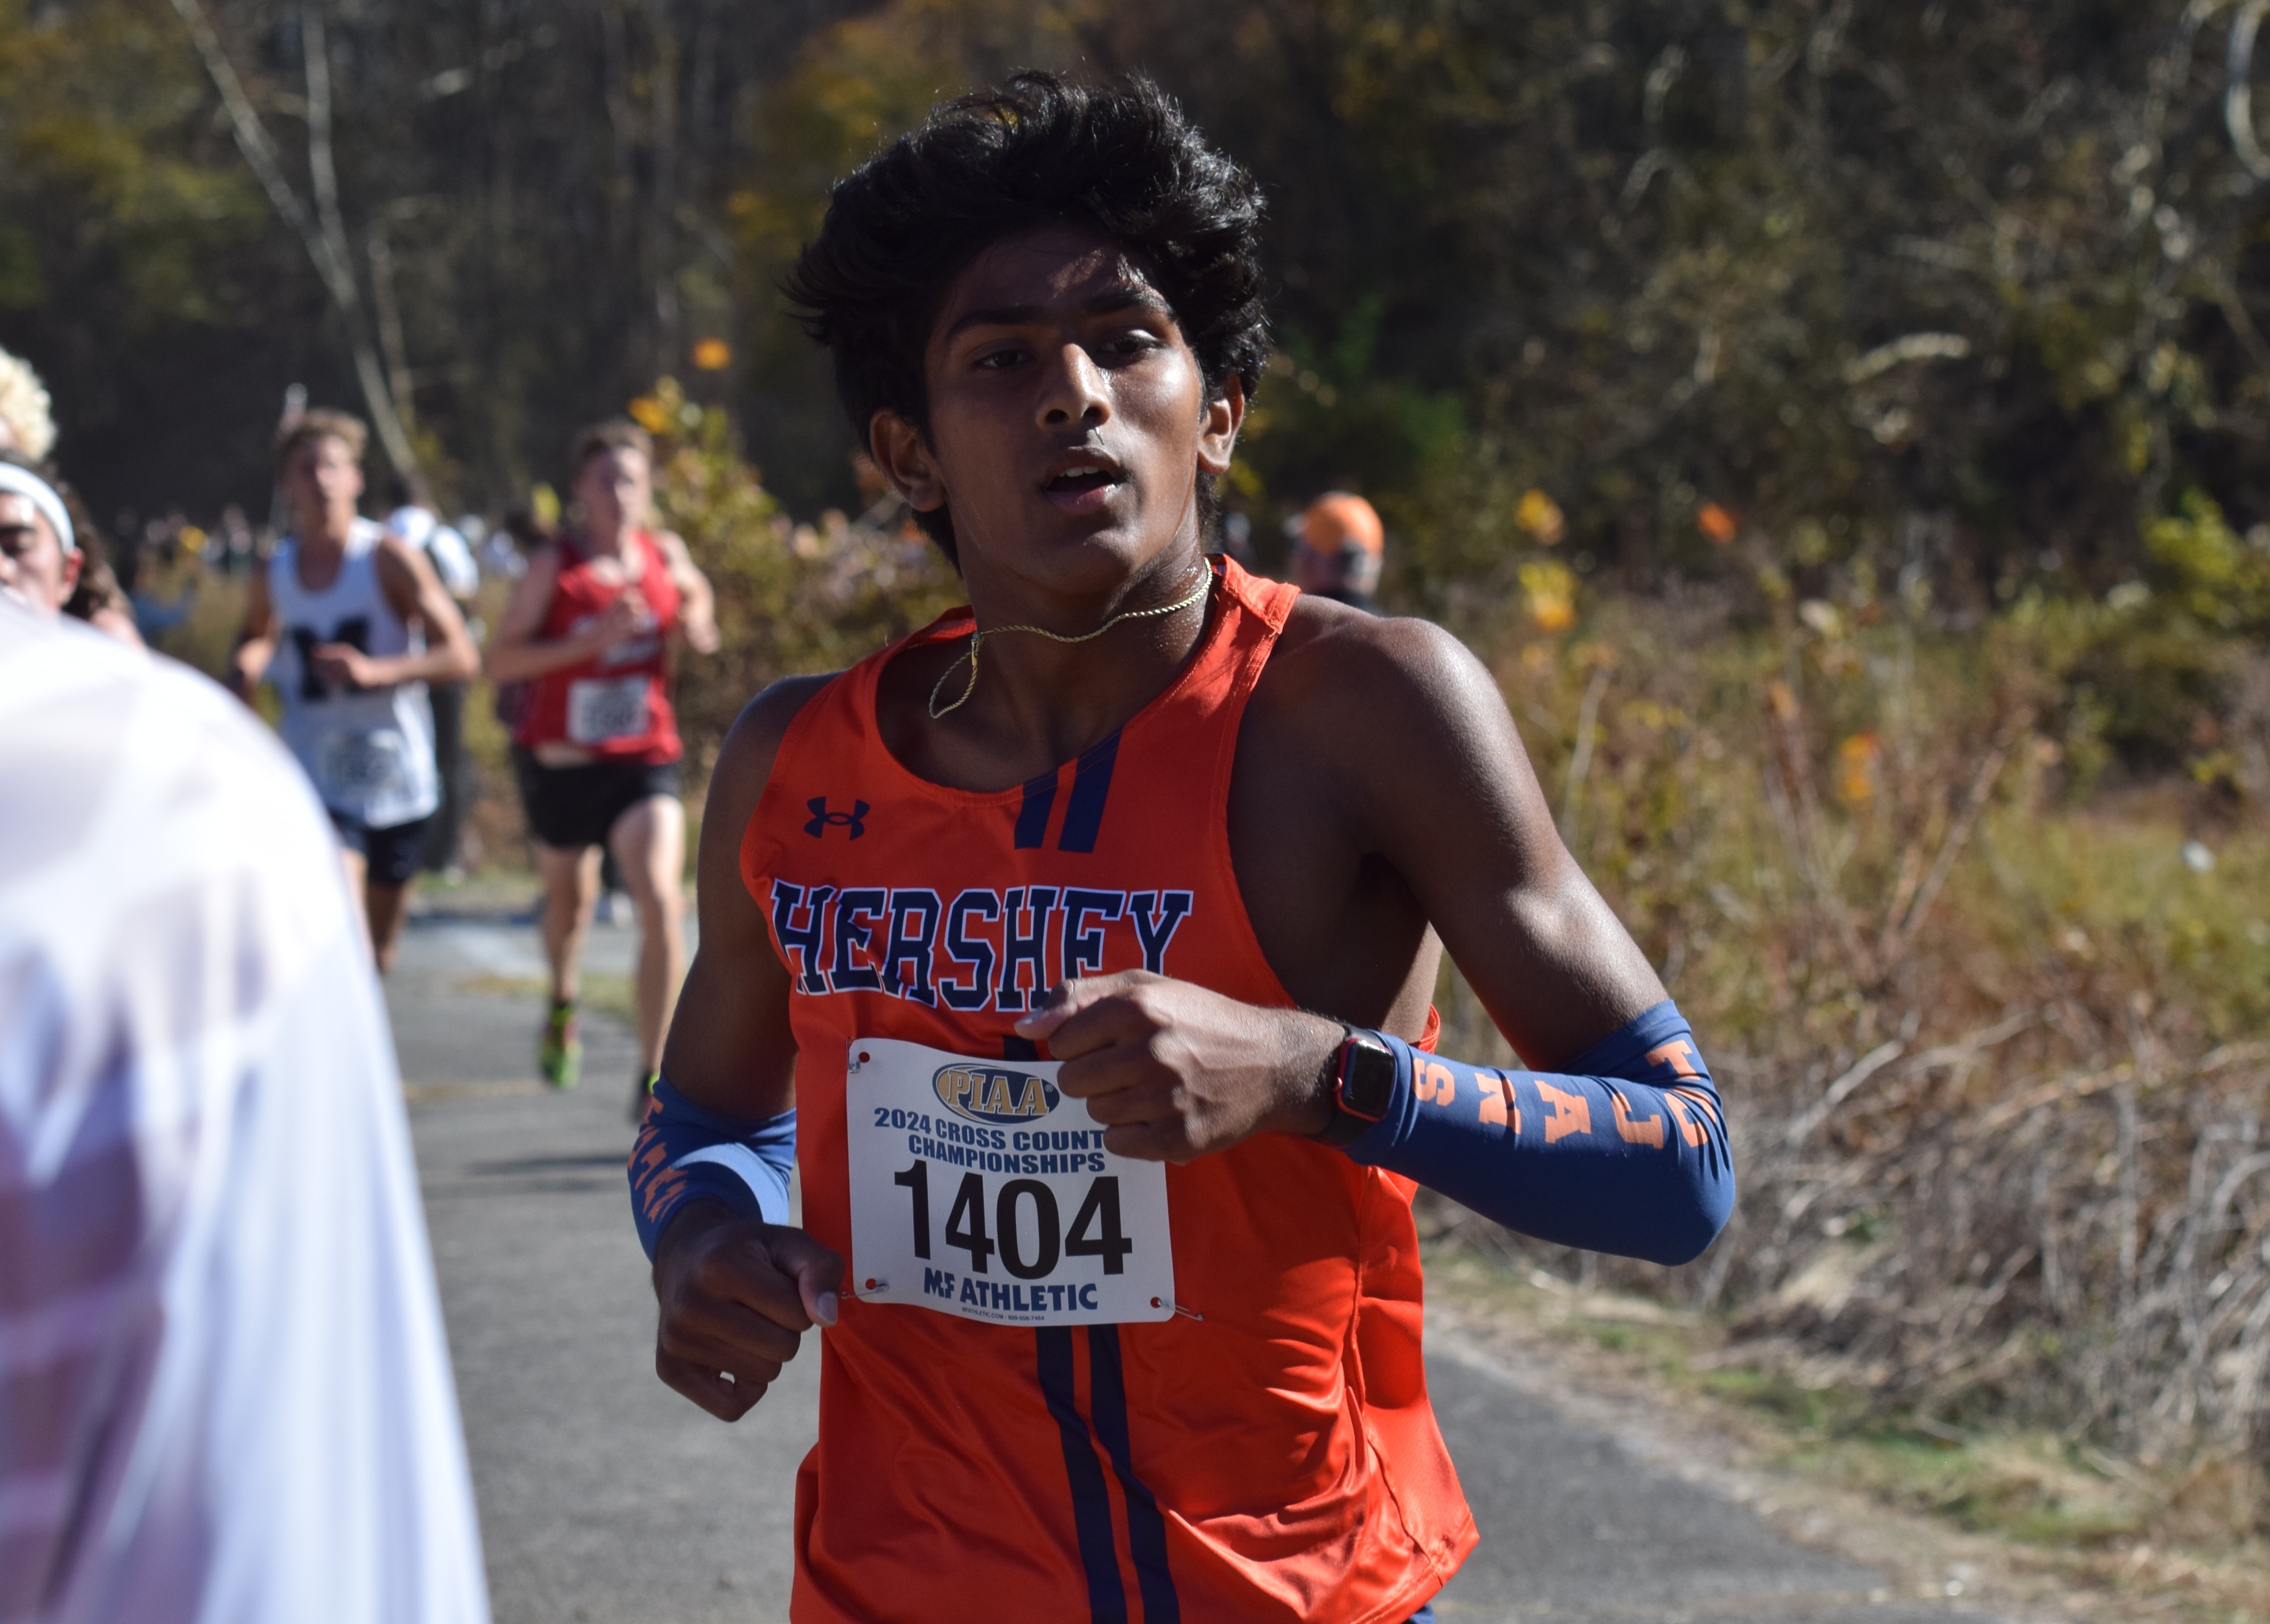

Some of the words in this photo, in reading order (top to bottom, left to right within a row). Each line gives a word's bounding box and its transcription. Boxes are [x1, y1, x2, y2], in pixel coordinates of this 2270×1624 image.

[771, 877, 1194, 1012] HERSHEY
[947, 1069, 1049, 1116] PIAA
[874, 1107, 931, 1134] 2024
[935, 1118, 1006, 1150] CROSS
[1012, 1129, 1106, 1152] COUNT
[908, 1134, 1106, 1174] CHAMPIONSHIPS
[894, 1159, 1133, 1280] 1404
[923, 1266, 955, 1299] MF
[960, 1277, 1098, 1312] ATHLETIC
[962, 1306, 1004, 1319] MFATHLETIC.COM
